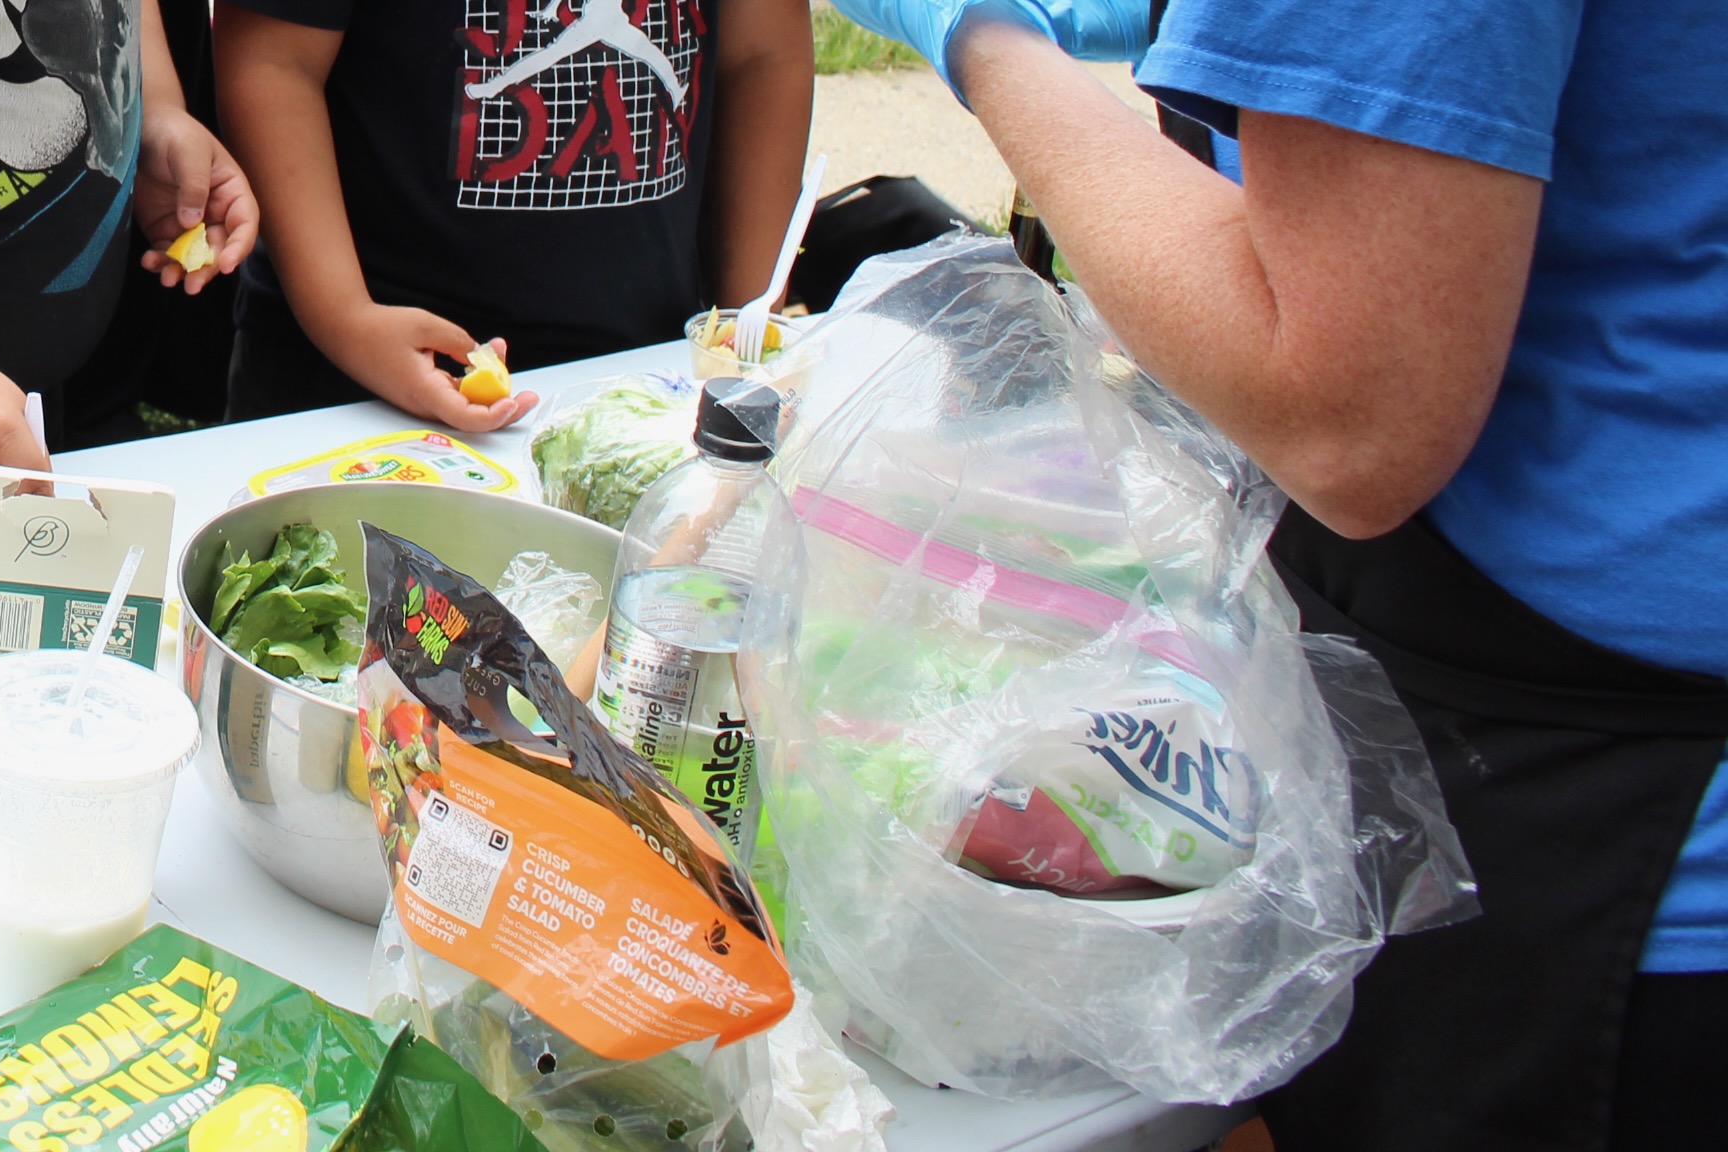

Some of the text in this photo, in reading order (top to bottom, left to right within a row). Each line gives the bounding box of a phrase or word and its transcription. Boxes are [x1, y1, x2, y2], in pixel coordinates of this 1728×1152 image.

[73, 602, 102, 610] WINDOW
[74, 608, 102, 616] PLASTIC
[425, 585, 468, 642] RED SUN
[416, 616, 450, 665] FARMS
[449, 779, 496, 808] SCAN FOR
[456, 793, 488, 815] RECIPE
[526, 842, 570, 872] CRISP
[514, 877, 595, 929] & TOMATO
[522, 859, 606, 917] CUCUMBER
[404, 893, 467, 938] SCANNEZ POUR
[416, 915, 456, 945] RECETTE
[507, 895, 560, 932] SALAD
[630, 897, 694, 942] SALADE
[607, 952, 677, 1004] TOMATES
[617, 935, 727, 1010] CONCOMBRES
[728, 1000, 754, 1018] ET
[626, 917, 724, 983] CROQUANTE
[722, 974, 750, 999] DE
[8, 971, 238, 1152] SEEDLESS
[116, 1055, 238, 1149] Naturally
